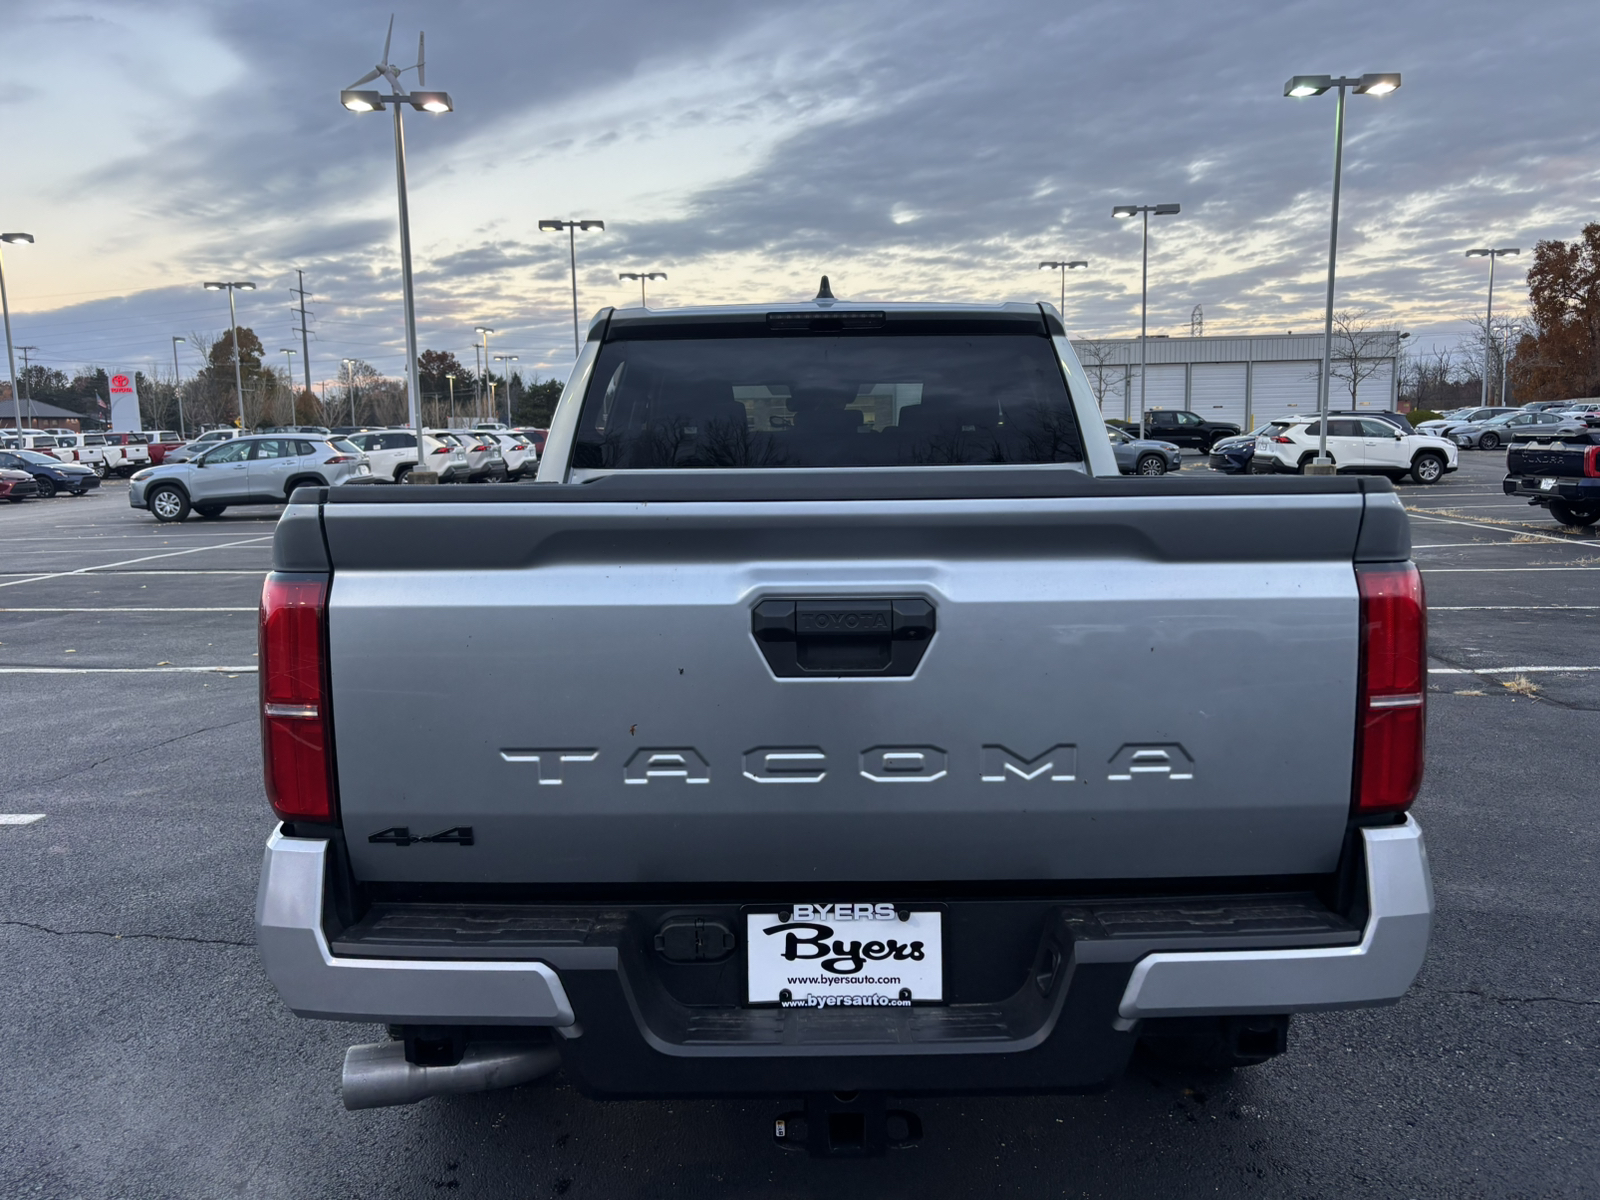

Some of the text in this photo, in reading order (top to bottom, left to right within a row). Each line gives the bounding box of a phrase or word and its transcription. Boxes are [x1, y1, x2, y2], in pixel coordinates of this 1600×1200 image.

[801, 613, 888, 628] TOYOTA
[500, 743, 1195, 785] TACOMA
[793, 903, 895, 921] BYERS
[762, 922, 925, 974] Byers
[787, 974, 901, 986] www.byersauto.com
[781, 992, 911, 1009] www.byersauto.com
